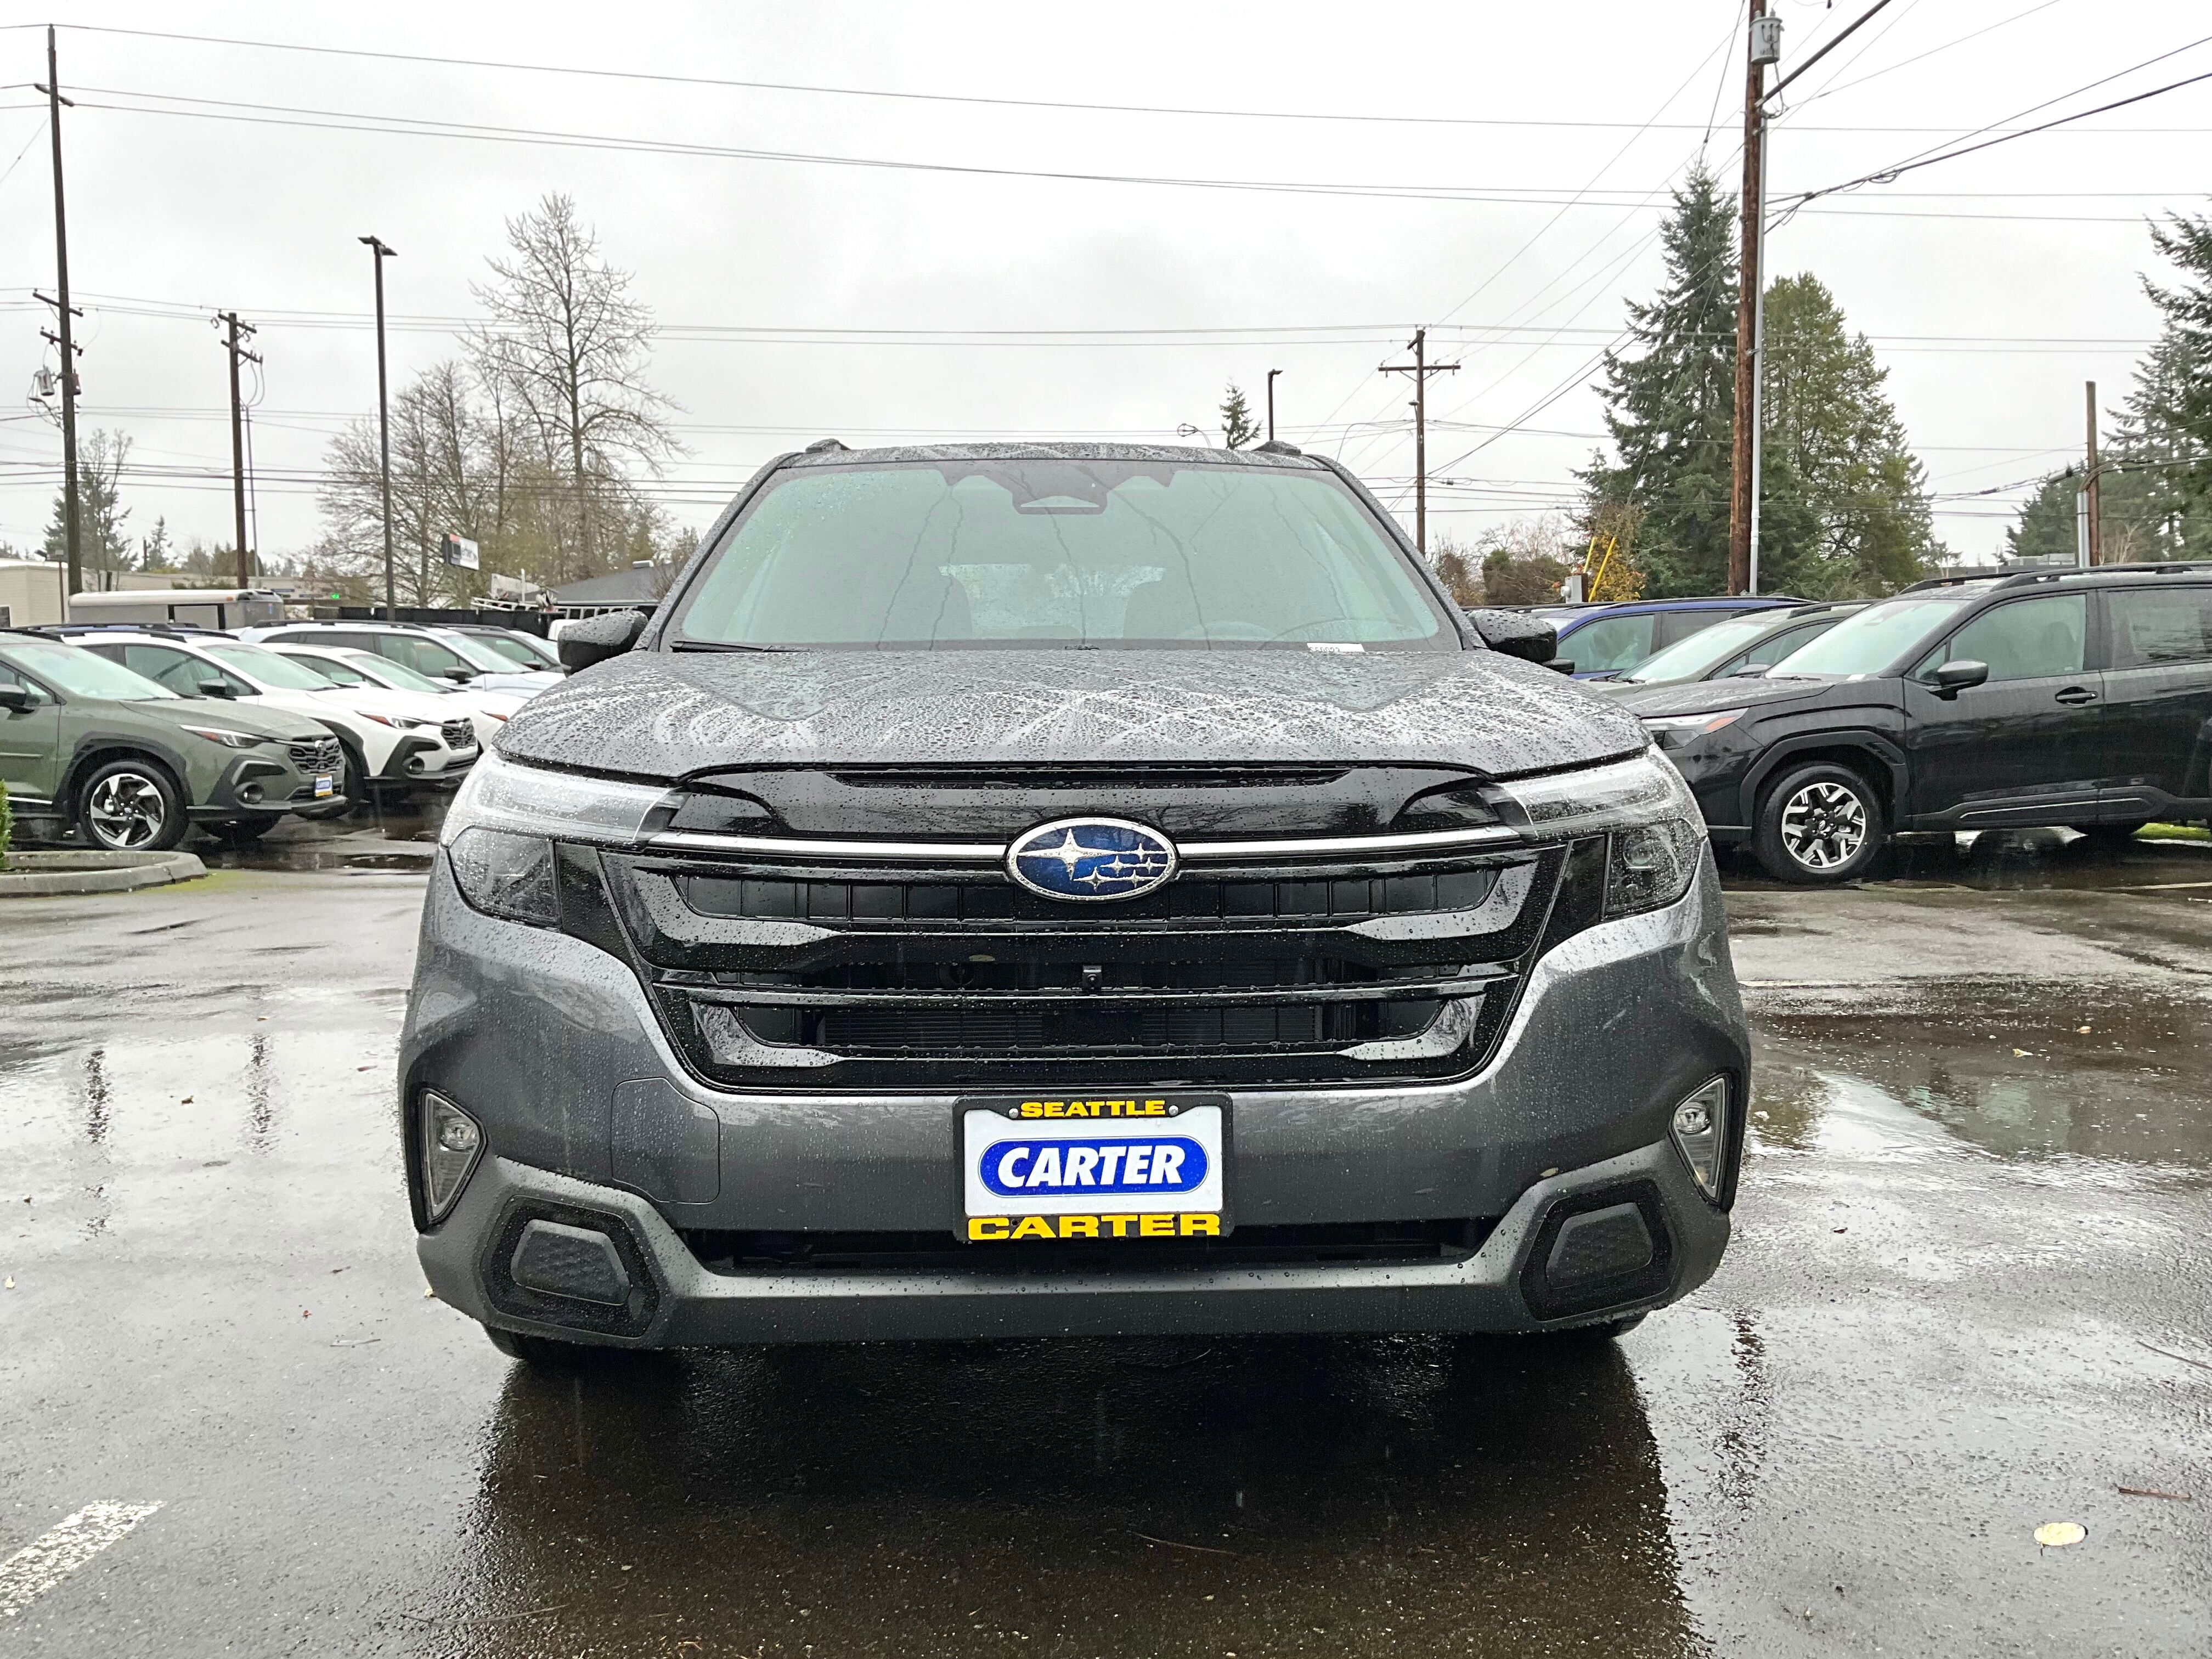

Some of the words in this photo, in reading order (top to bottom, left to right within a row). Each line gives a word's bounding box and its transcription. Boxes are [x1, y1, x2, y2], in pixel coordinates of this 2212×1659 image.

[1020, 1099, 1166, 1118] SEATTLE
[997, 1145, 1186, 1188] CARTER
[968, 1213, 1221, 1240] CARTER
